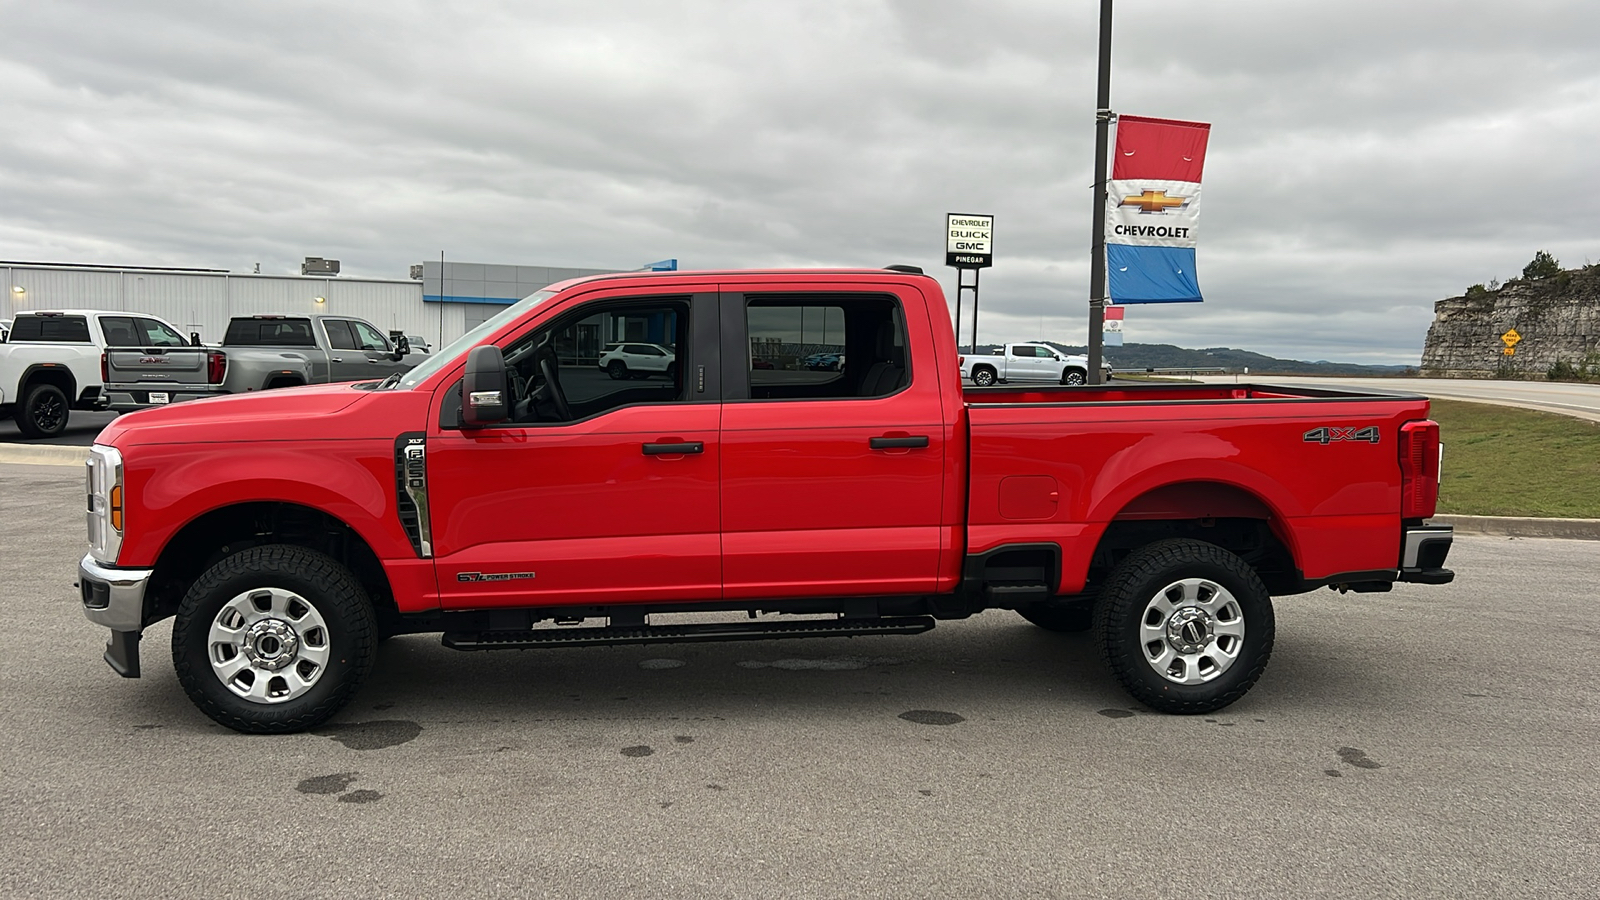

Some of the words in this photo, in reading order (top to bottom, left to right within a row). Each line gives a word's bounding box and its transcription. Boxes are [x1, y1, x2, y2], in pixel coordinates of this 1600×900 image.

[951, 219, 990, 227] CHEVROLET
[951, 230, 989, 239] BUICK
[1114, 225, 1189, 238] CHEVROLET
[956, 242, 984, 250] GMC
[955, 255, 984, 264] PINEGAR
[139, 356, 170, 364] GMC
